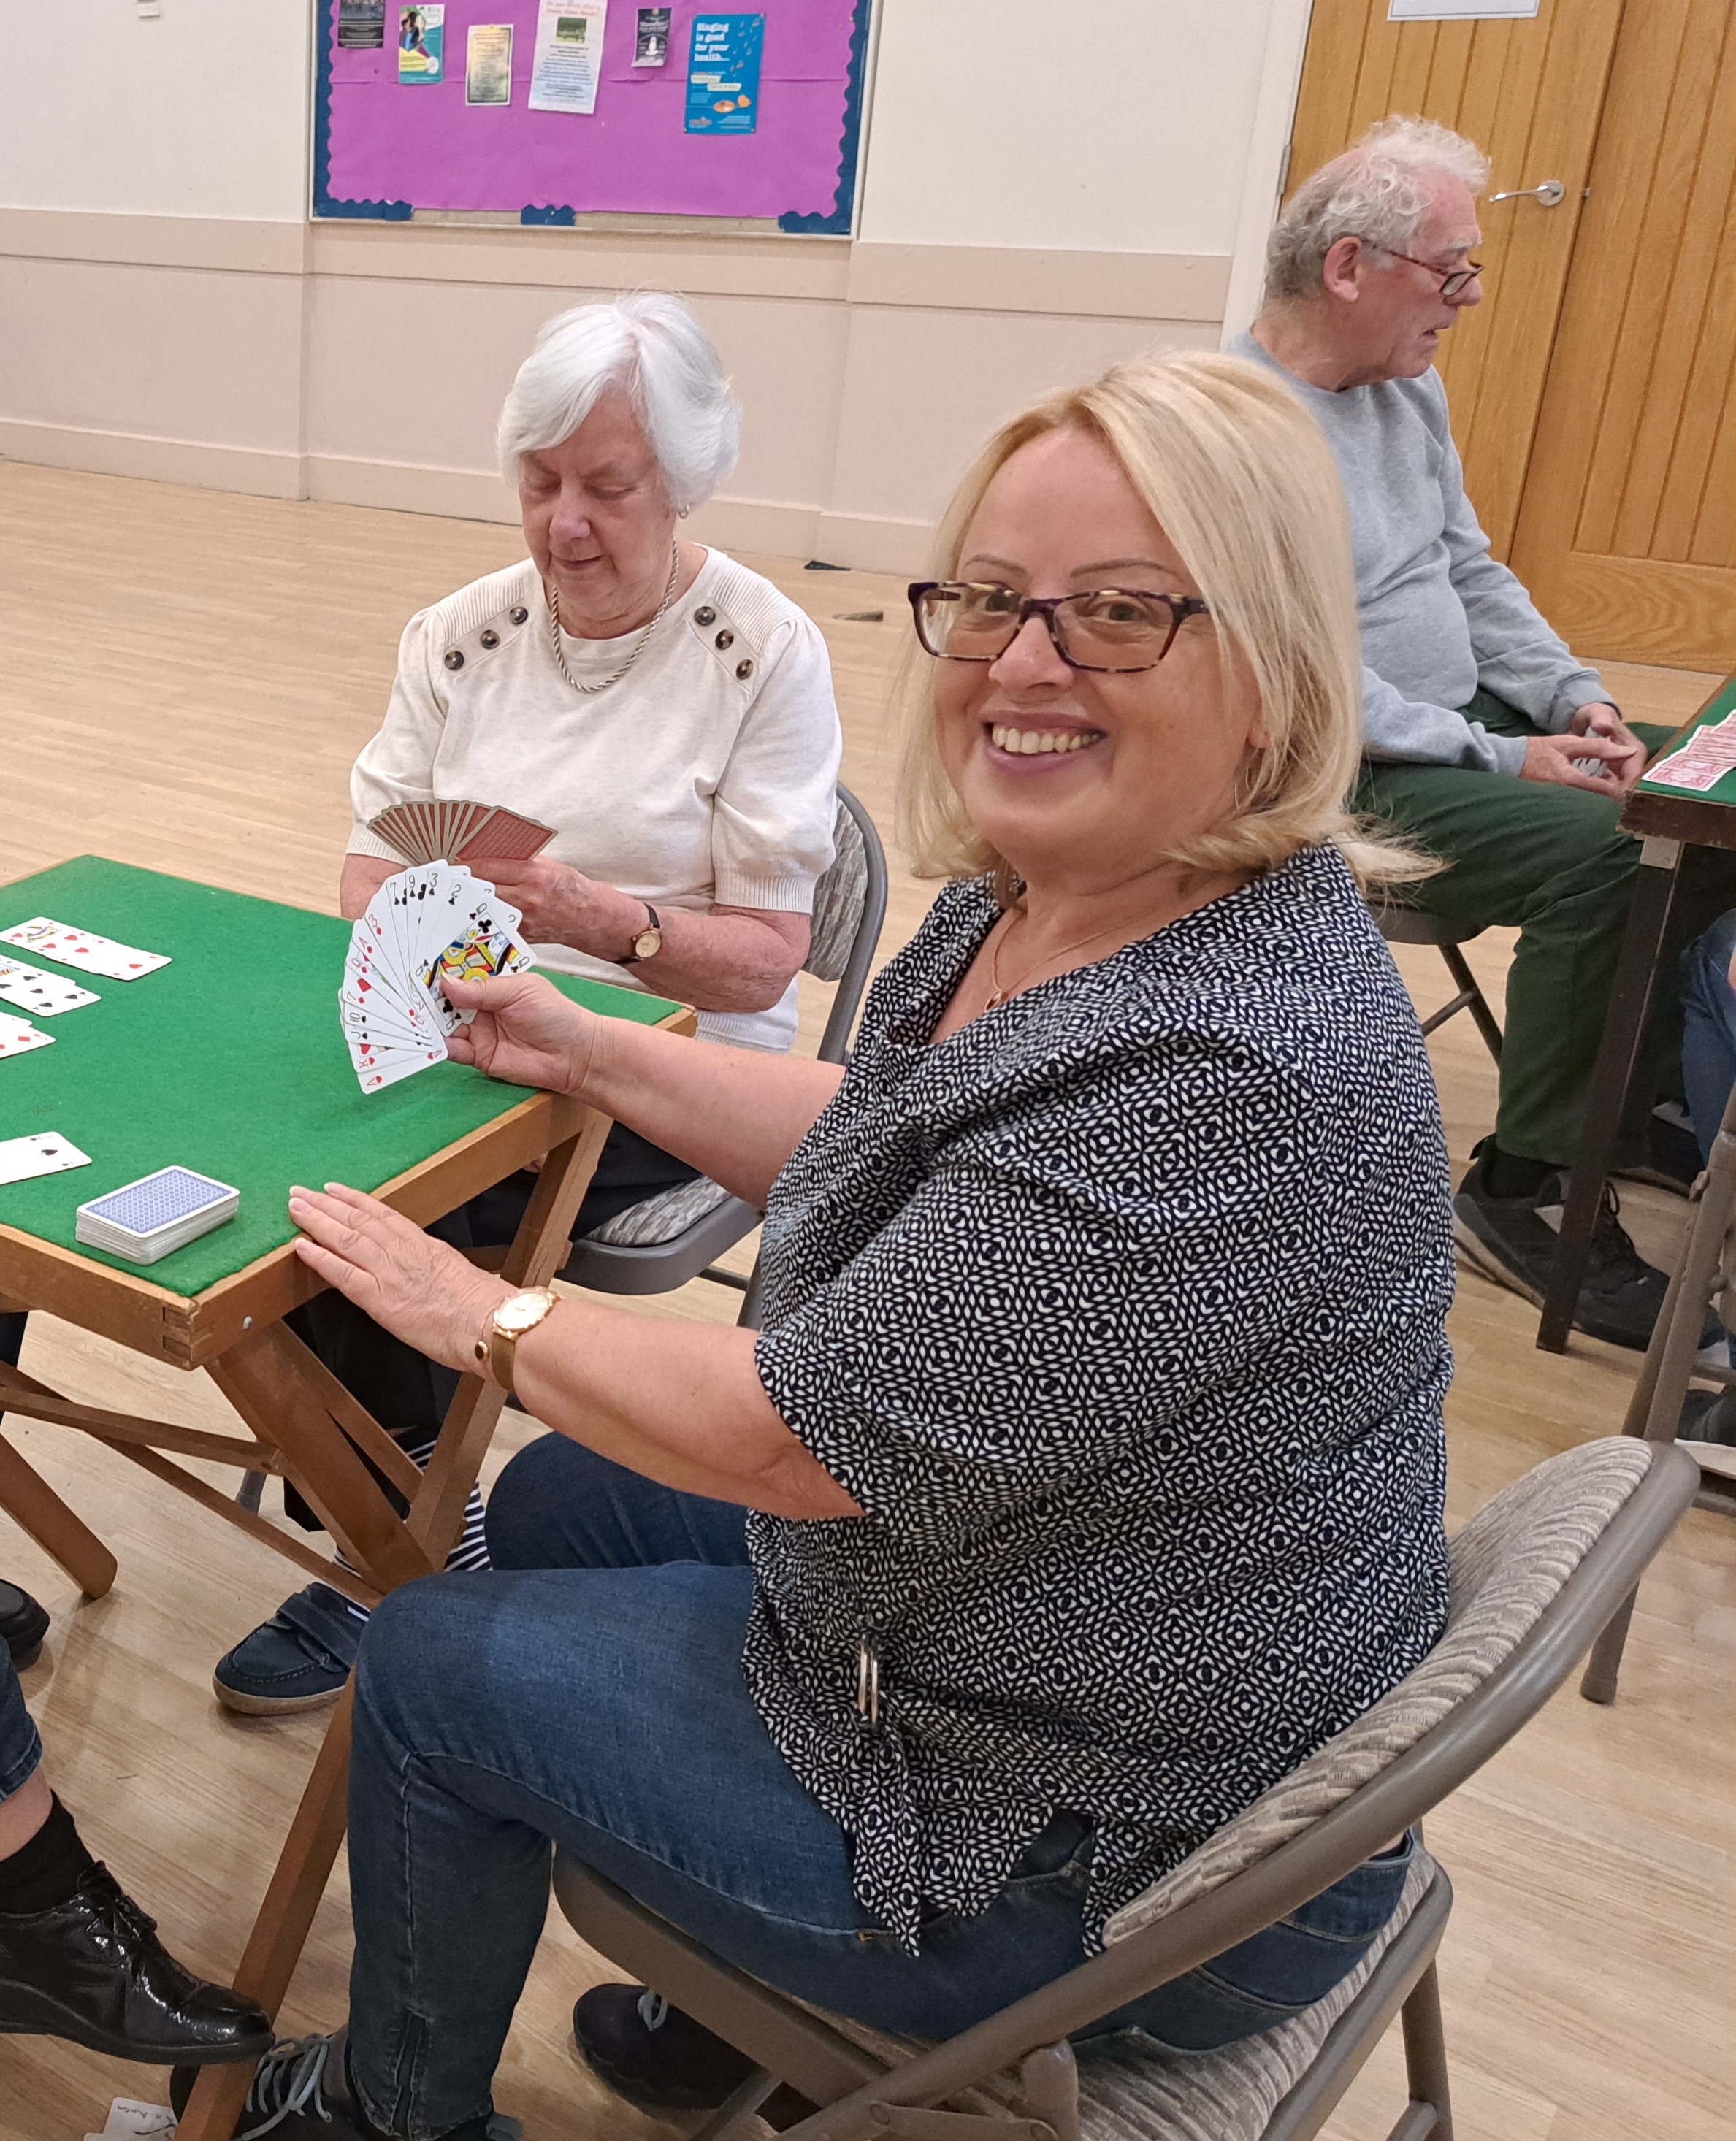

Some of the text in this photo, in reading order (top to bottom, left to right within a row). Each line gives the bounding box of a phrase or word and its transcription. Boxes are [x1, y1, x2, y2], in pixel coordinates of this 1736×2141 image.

[409, 875, 416, 889] 9
[430, 873, 438, 887] 3
[390, 882, 397, 897] 7
[451, 884, 462, 898] 2
[368, 914, 378, 927] 3
[359, 937, 367, 949] A
[347, 991, 356, 1001] 7
[349, 1012, 361, 1022] 10
[351, 1030, 361, 1040] J
[358, 1059, 369, 1069] K
[367, 1077, 377, 1087] A
